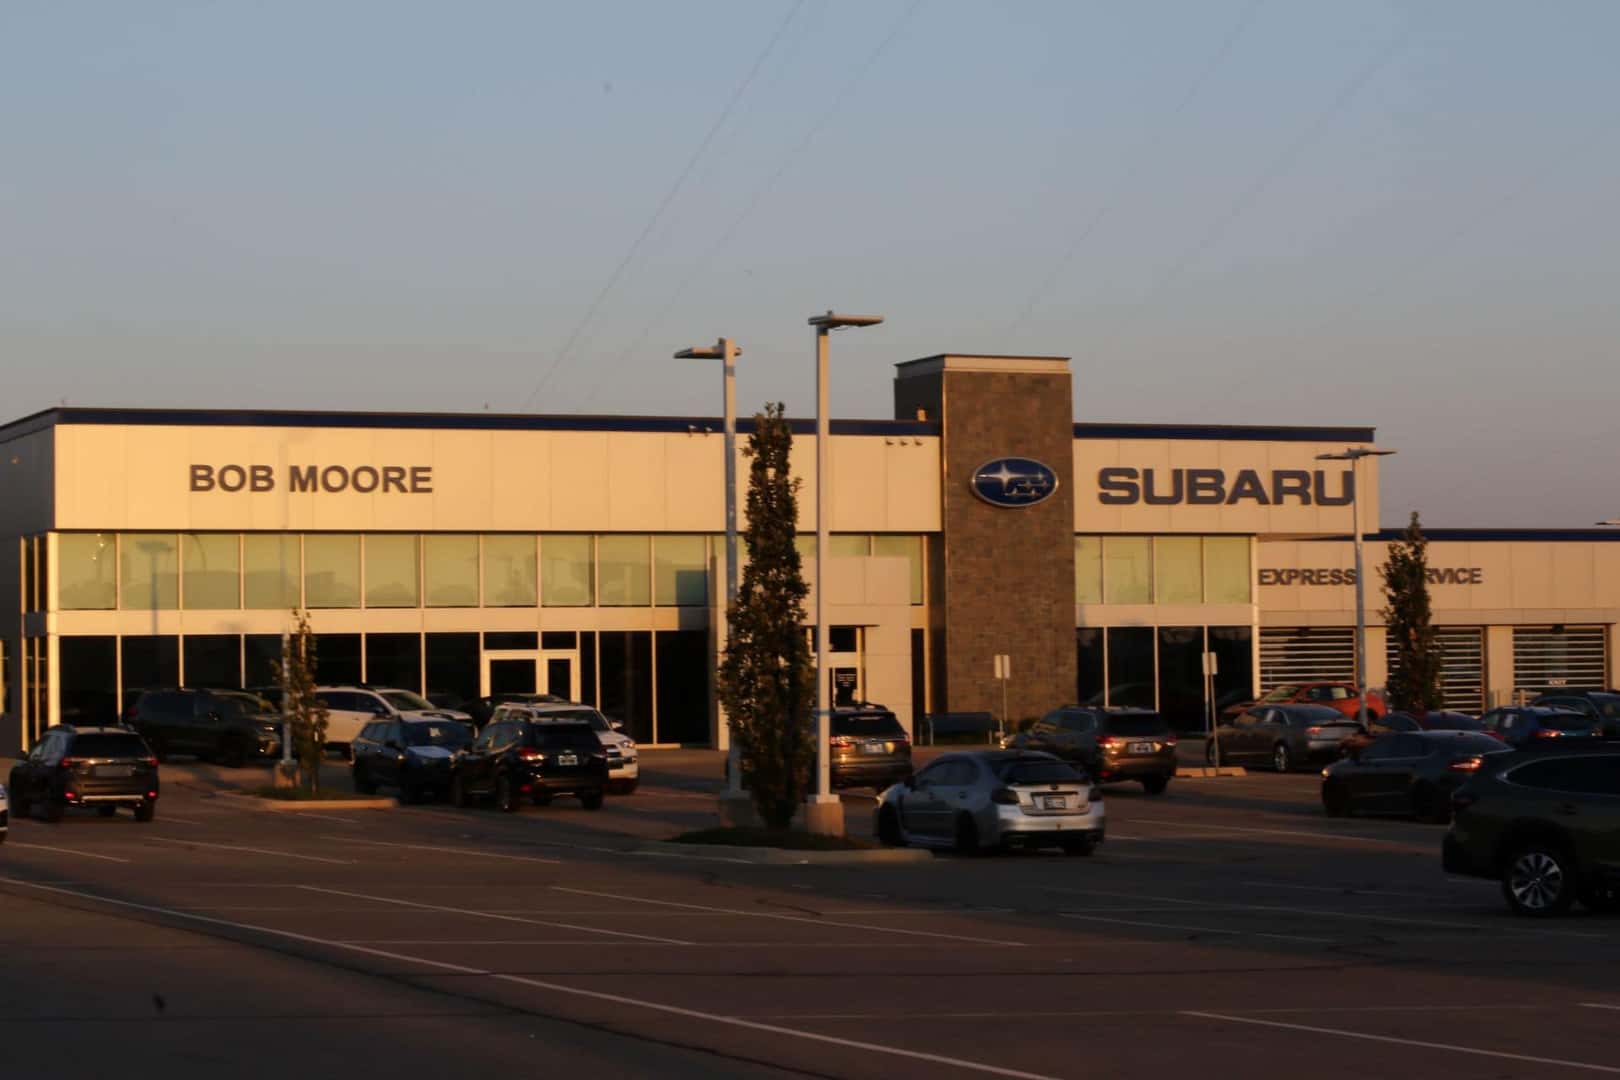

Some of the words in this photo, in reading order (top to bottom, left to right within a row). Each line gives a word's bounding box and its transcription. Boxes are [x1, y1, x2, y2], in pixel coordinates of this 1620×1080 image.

[190, 464, 275, 492] BOB
[289, 465, 433, 493] MOORE
[1098, 467, 1355, 506] SUBARU
[1258, 568, 1358, 586] EXPRESS
[1423, 567, 1483, 585] RVICE
